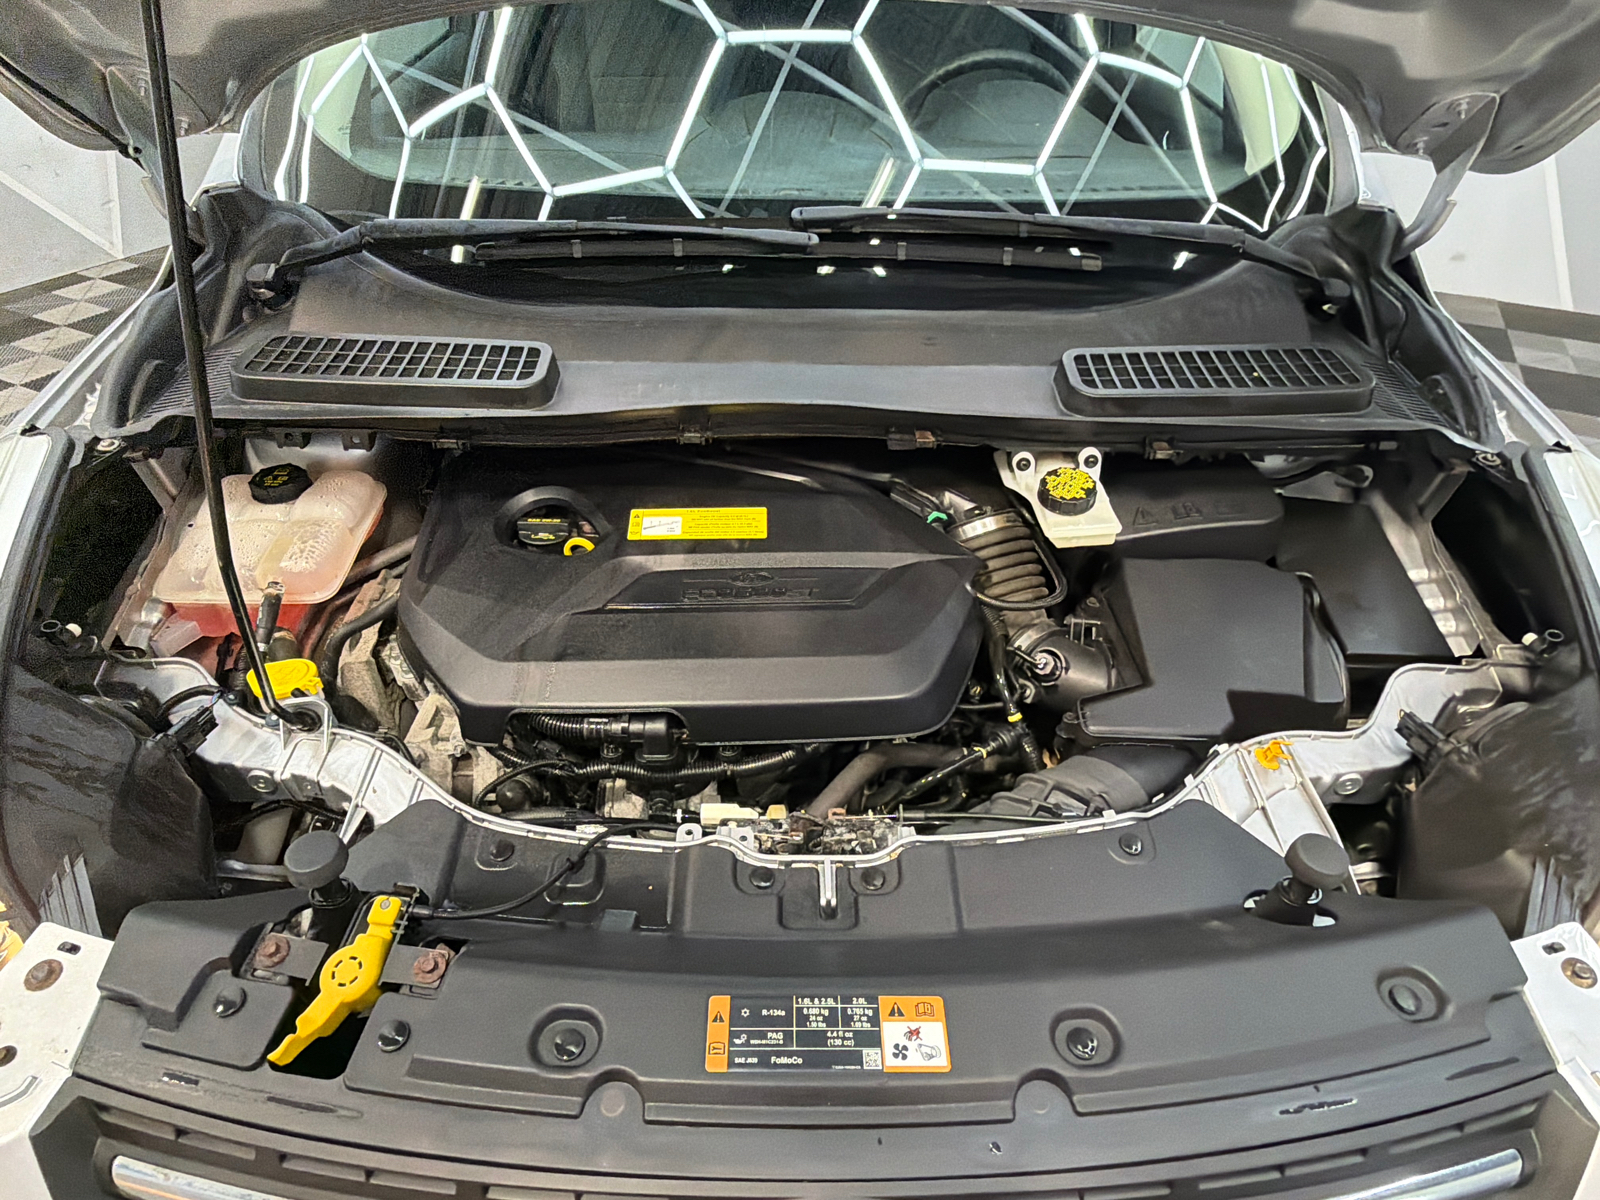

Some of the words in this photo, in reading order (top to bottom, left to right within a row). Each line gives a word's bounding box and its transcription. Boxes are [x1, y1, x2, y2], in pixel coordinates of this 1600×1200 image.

[761, 1008, 786, 1017] R-134a
[820, 1007, 830, 1017] kg
[864, 1007, 874, 1017] kg
[767, 1032, 784, 1040] PAG
[827, 1039, 843, 1047] (130
[843, 1039, 855, 1047] cc)
[770, 1055, 804, 1065] FoMoCo
